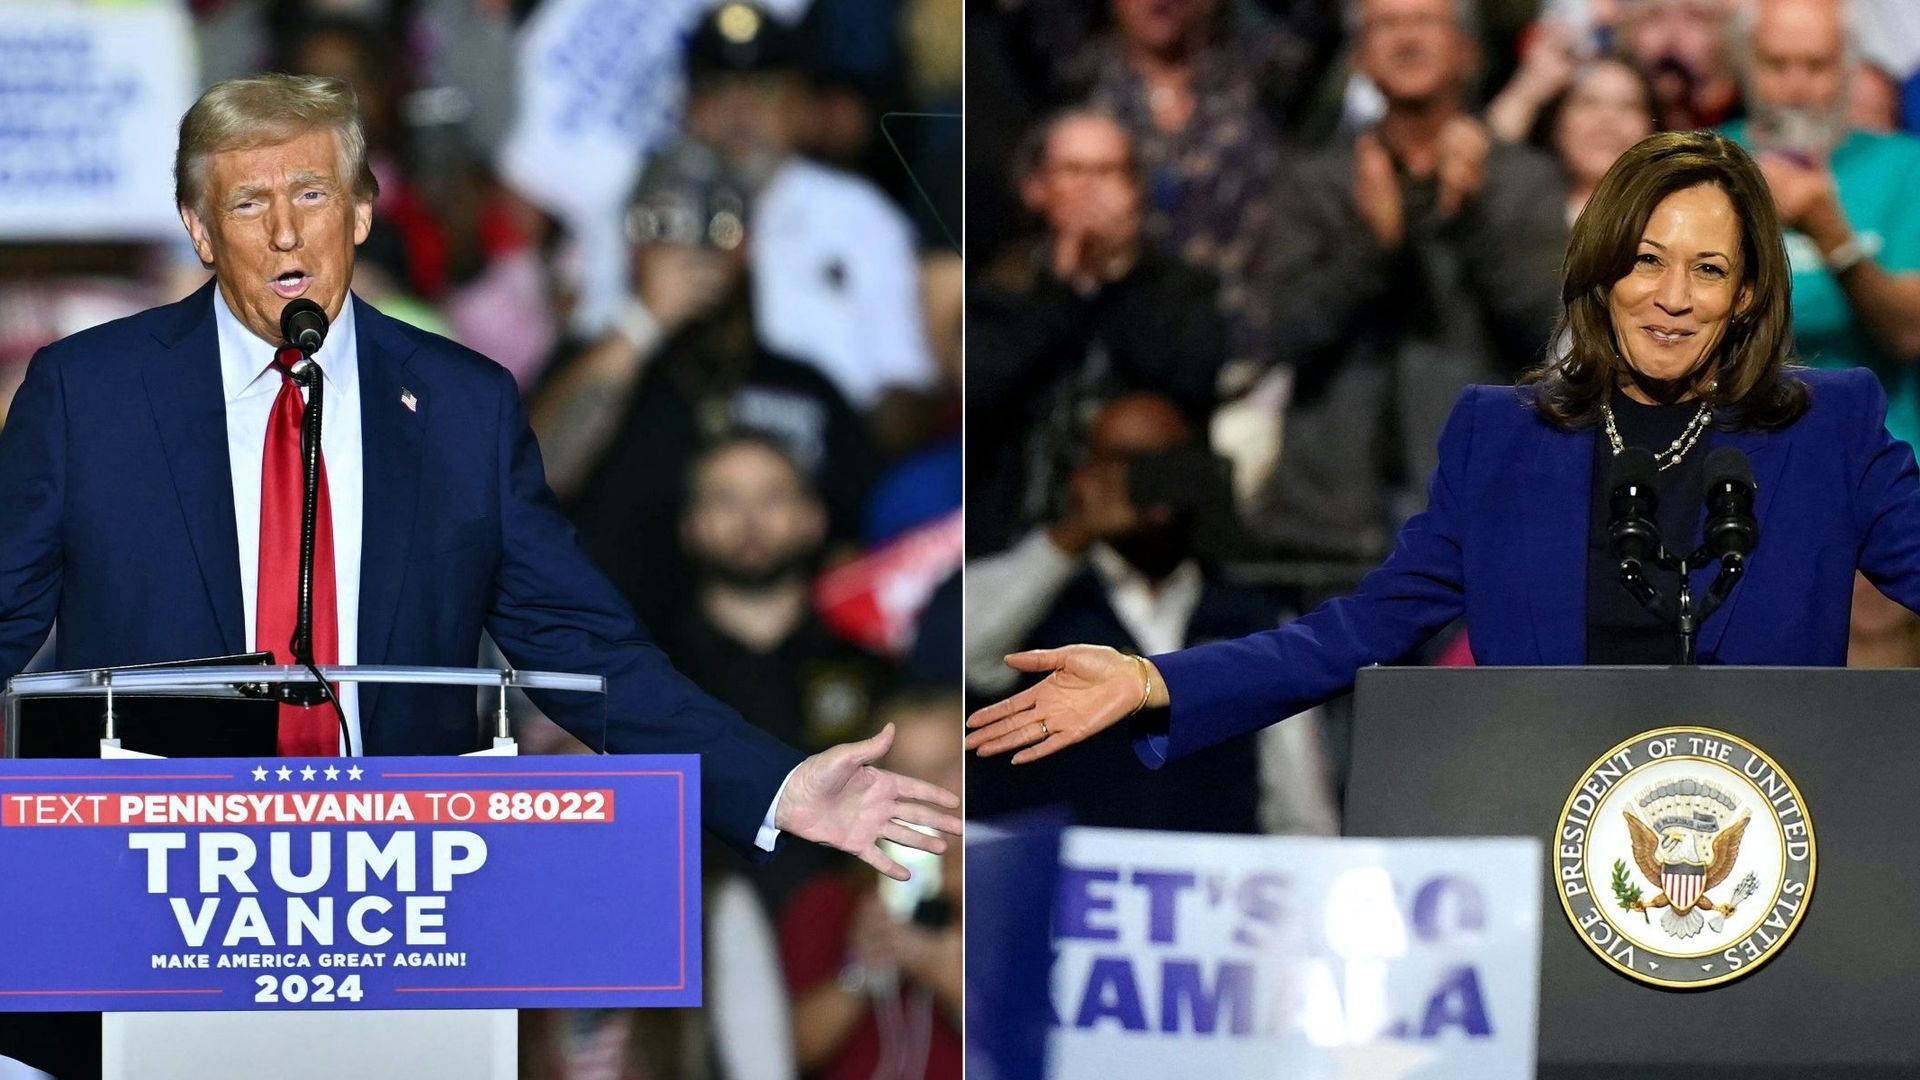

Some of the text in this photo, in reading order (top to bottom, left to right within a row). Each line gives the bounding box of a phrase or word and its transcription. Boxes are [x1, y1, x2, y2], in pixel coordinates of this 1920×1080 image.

[11, 791, 605, 824] TEXT PENNSYLVANIA TO 88022
[128, 830, 488, 893] TRUMP
[1560, 737, 1809, 970] VICE PRESIDENT OF THE UNITED STATES
[169, 895, 447, 947] VANCE
[1053, 868, 1291, 946] ET'S
[151, 952, 467, 968] MAKE AMERICA GREAT AGAIN!
[254, 974, 364, 1003] 2024
